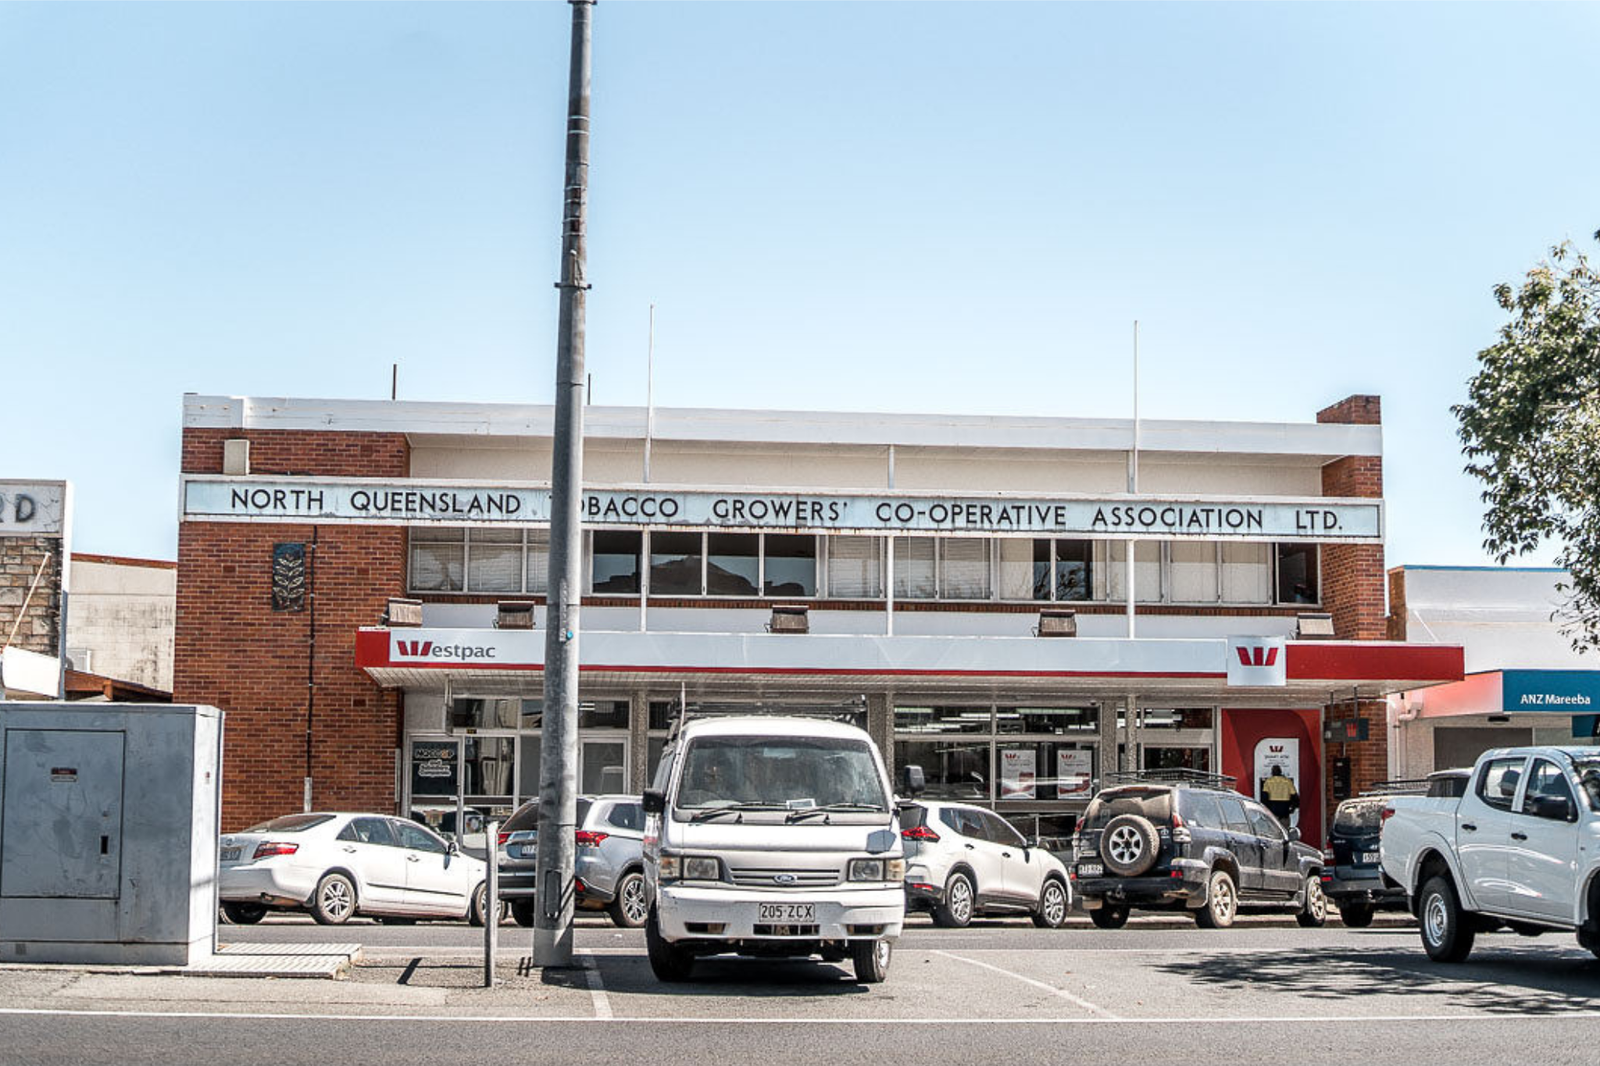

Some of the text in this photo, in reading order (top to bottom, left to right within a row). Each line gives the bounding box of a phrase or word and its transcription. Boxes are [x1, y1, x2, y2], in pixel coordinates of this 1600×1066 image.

[0, 493, 36, 523] D
[230, 488, 324, 511] NORTH
[350, 490, 522, 515] QUEENSLAND
[549, 495, 679, 518] BACCO
[875, 502, 1067, 526] CO-OPERATIVE
[1091, 506, 1263, 529] ASSOCIATION
[1295, 509, 1343, 531] LTD.
[397, 640, 496, 661] Westpac
[1520, 692, 1591, 705] ANZ Mareeba
